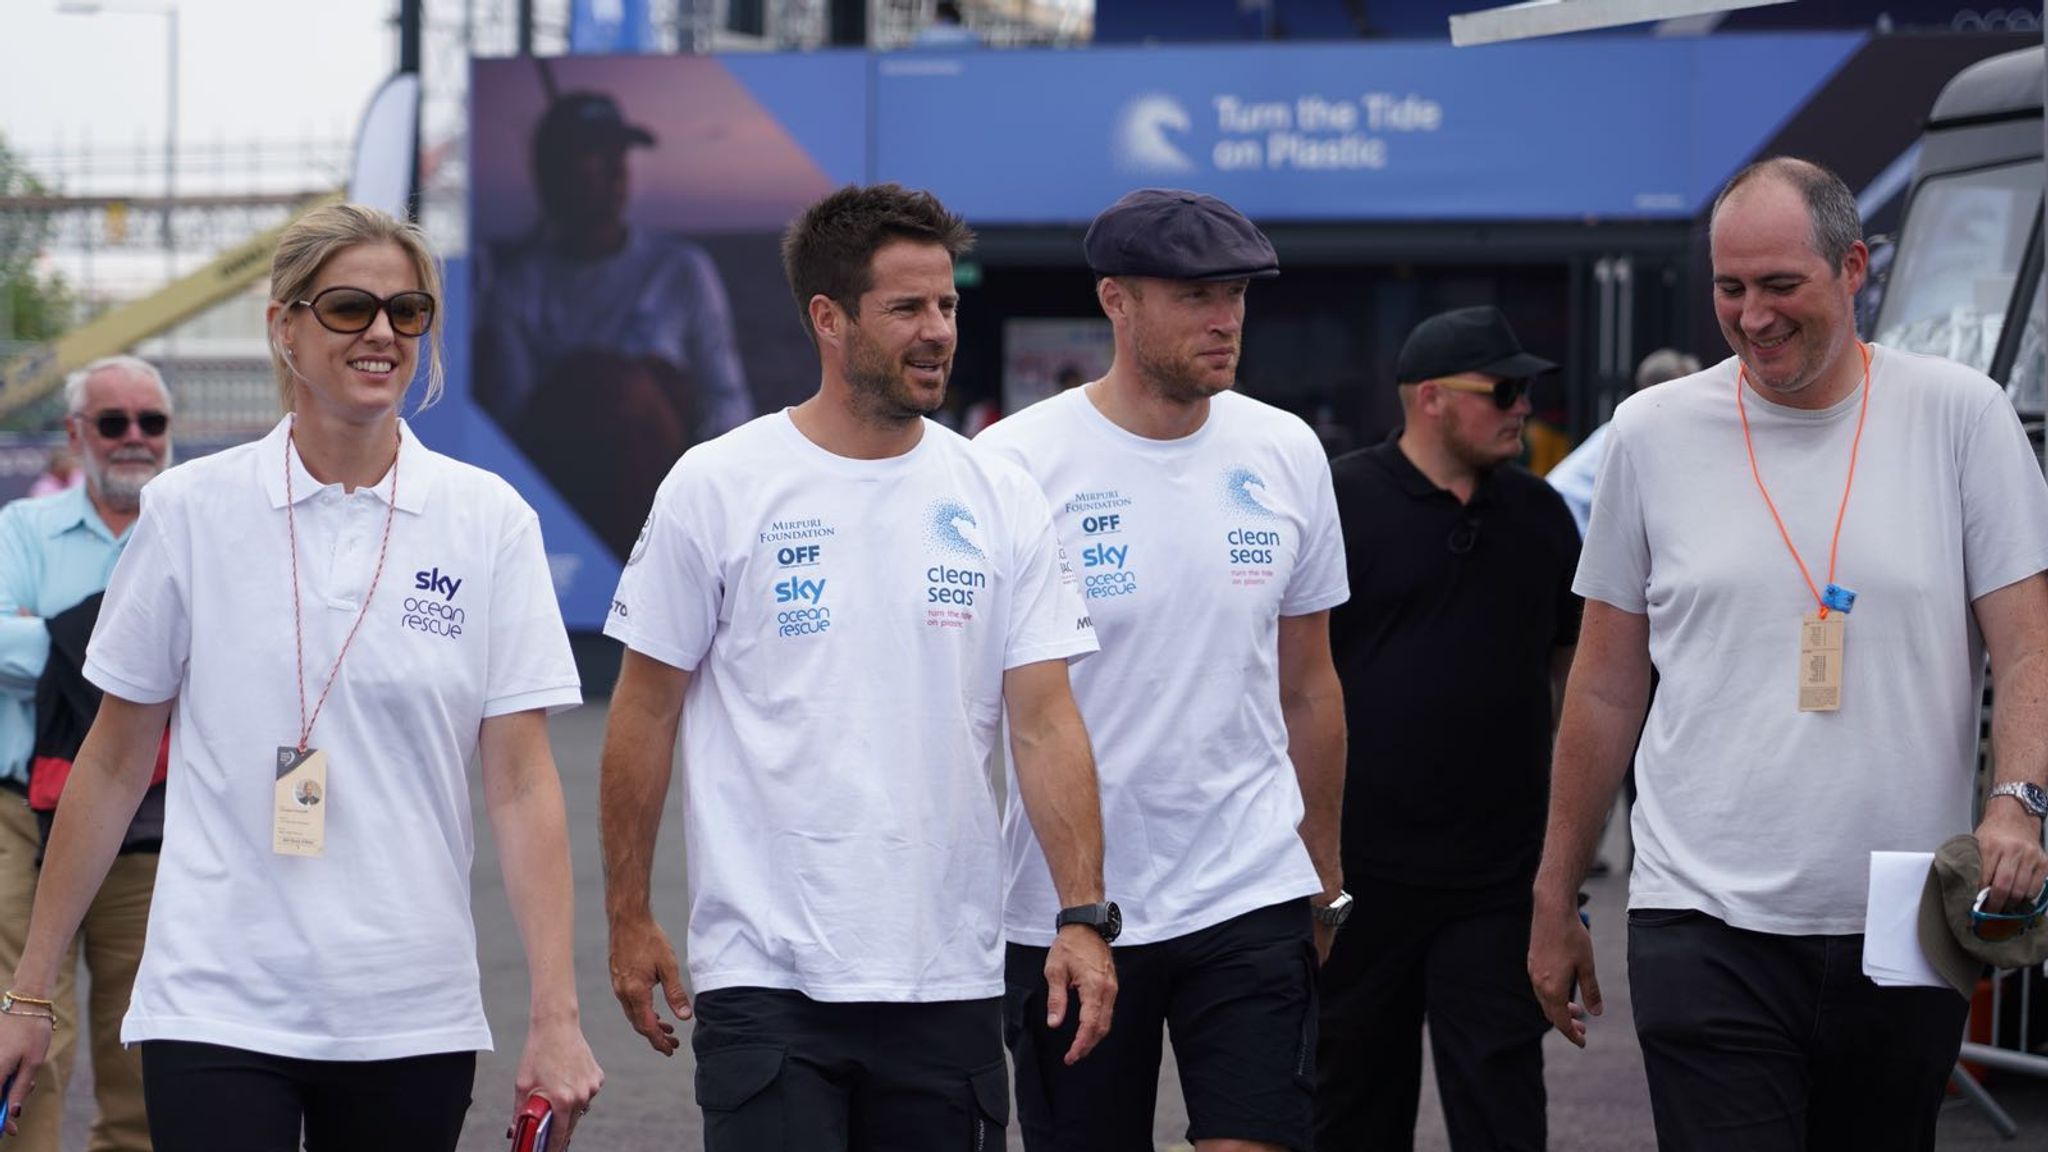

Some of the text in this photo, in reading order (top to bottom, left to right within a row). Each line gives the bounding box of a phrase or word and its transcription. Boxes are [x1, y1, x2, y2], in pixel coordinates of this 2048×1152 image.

[1214, 93, 1442, 131] Turn the Tide
[1213, 132, 1387, 171] on Plastic
[1065, 497, 1132, 513] FOUNDATION
[1075, 490, 1119, 503] MIRPURI
[772, 518, 821, 531] MIRPURI
[1082, 514, 1120, 533] OFF
[760, 527, 835, 543] FOUNDATION
[1227, 528, 1280, 546] clean
[777, 545, 820, 565] OFF
[1082, 543, 1128, 569] sky
[1230, 548, 1273, 564] seas
[415, 567, 462, 601] sky
[927, 565, 985, 588] clean
[1085, 571, 1135, 588] ocean
[775, 576, 826, 604] sky
[927, 586, 974, 606] seas
[1086, 582, 1136, 600] rescue
[403, 597, 465, 624] ocean
[777, 607, 830, 624] ocean
[402, 614, 462, 640] rescue
[779, 619, 830, 637] rescue
